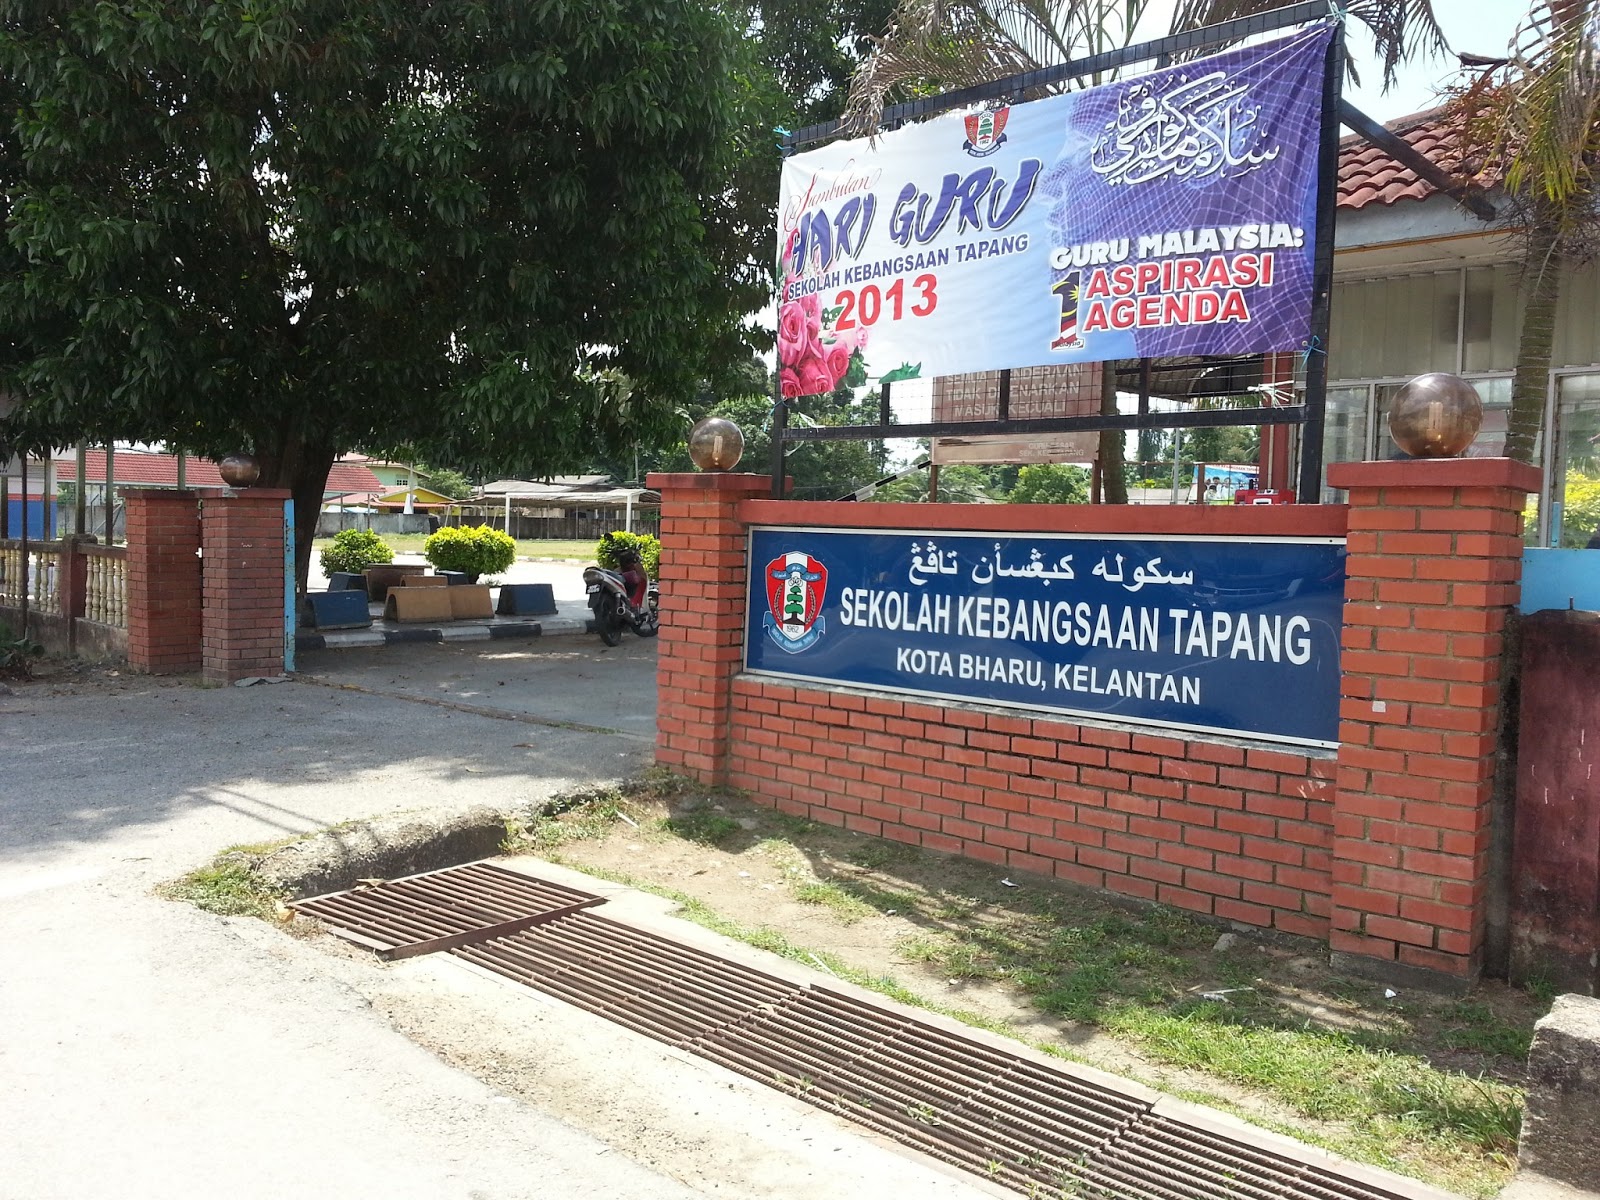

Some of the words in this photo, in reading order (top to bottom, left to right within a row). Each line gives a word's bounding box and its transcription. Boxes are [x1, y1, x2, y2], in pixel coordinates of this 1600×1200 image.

[791, 192, 877, 278] HARI
[889, 158, 1043, 248] GURU
[1050, 238, 1131, 271] GURU
[1138, 223, 1305, 260] MALAYSIA:
[788, 270, 840, 300] SEKOLAH
[844, 247, 949, 285] KEBANGSAAN
[955, 233, 1029, 263] TAPANG
[1084, 251, 1275, 299] ASPIRASI
[834, 273, 938, 332] 2013
[1082, 289, 1249, 332] AGENDA
[946, 387, 981, 401] TIDAK
[988, 381, 1080, 399] DIENARKAN
[839, 587, 951, 635] SEKOLAH
[957, 595, 1160, 653] KEBANGSAAN
[1168, 608, 1312, 666] TAPANG
[896, 647, 954, 678] KOTA
[959, 653, 1047, 692] BHARU,
[1054, 663, 1201, 706] KELANTAN
